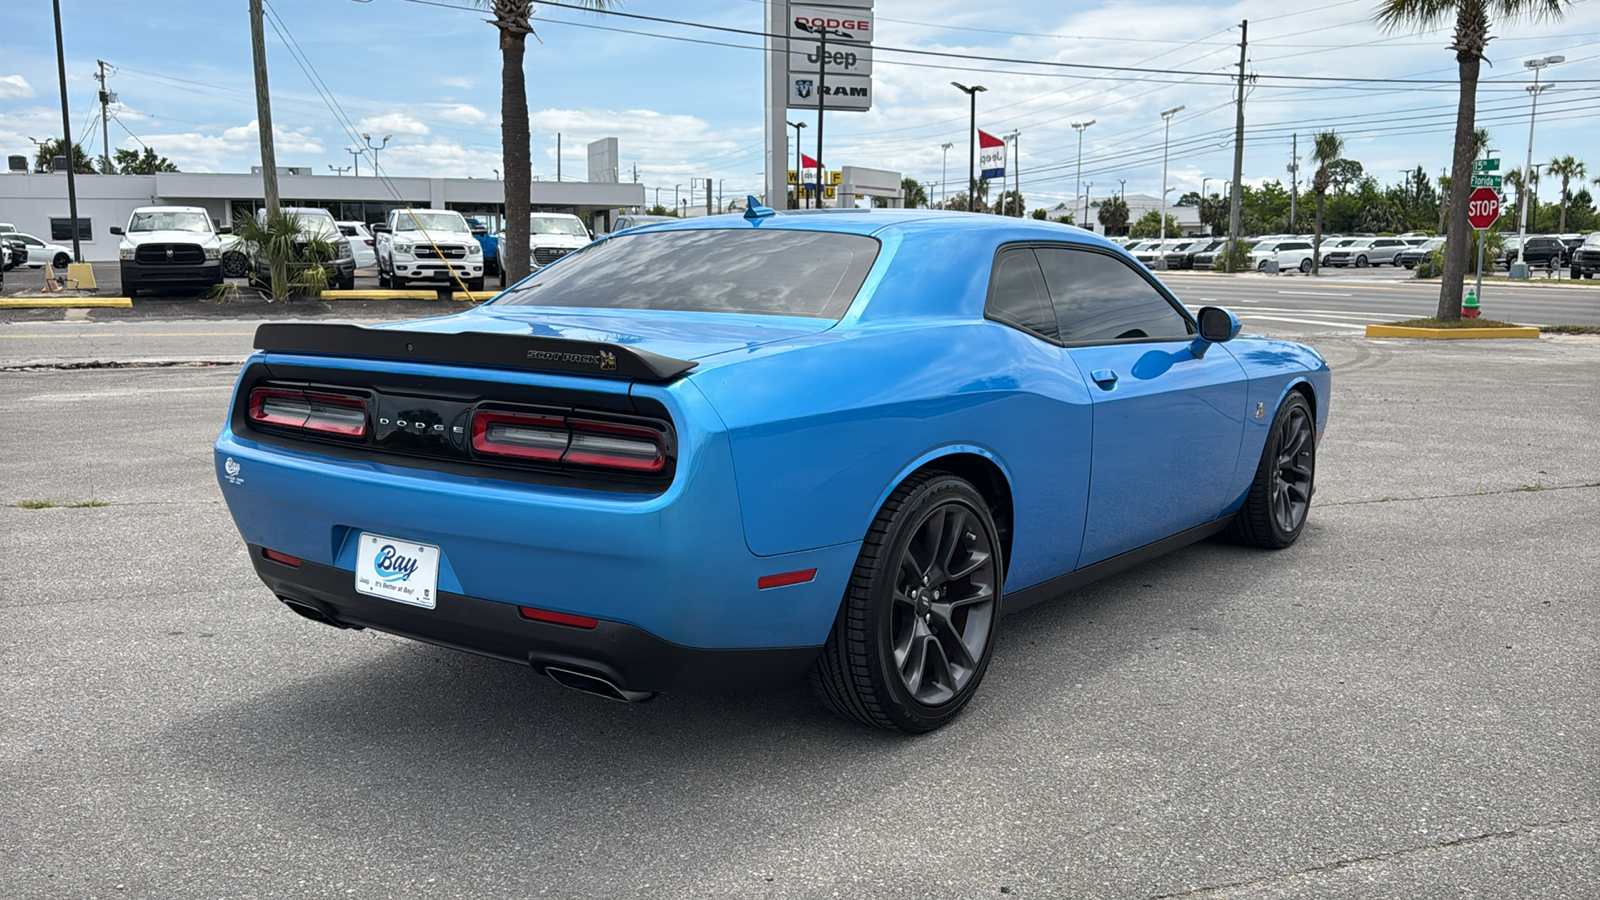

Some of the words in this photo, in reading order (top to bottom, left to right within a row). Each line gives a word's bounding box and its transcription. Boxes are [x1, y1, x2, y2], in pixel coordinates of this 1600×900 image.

[795, 17, 869, 31] DODGE
[807, 45, 857, 69] Jeep
[817, 85, 868, 97] RAM
[1475, 161, 1488, 171] 15th
[1471, 176, 1494, 186] Florida
[1468, 200, 1498, 217] STOP
[526, 350, 562, 361] SCAT
[562, 352, 600, 364] PACK
[379, 418, 464, 434] DODGE
[376, 544, 418, 581] Bay
[382, 582, 397, 591] Better
